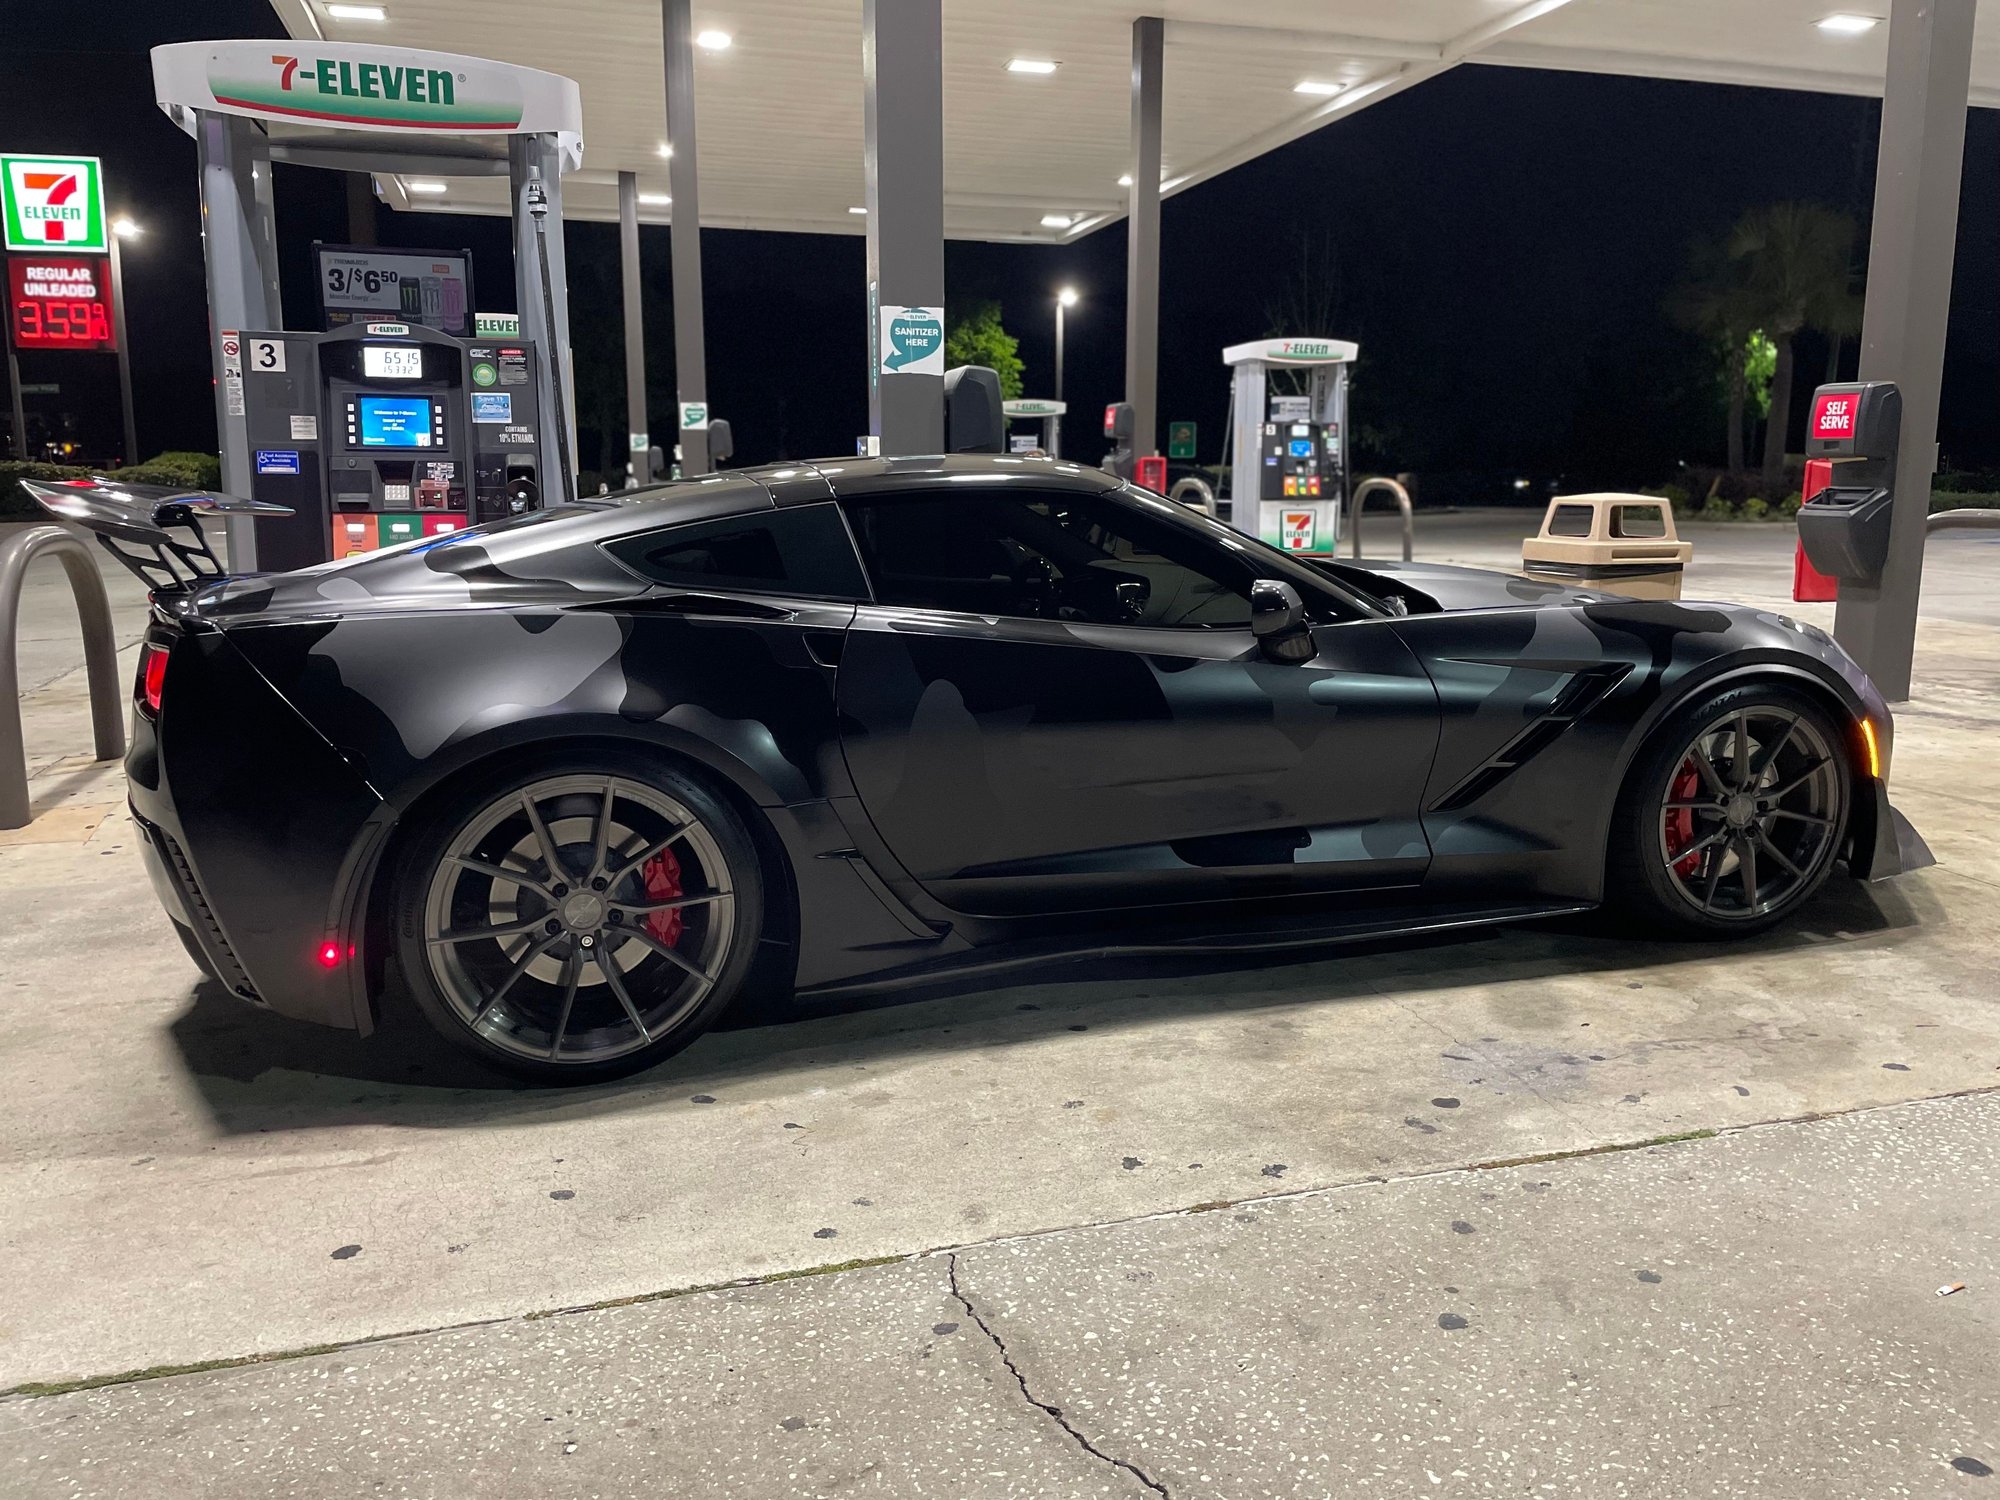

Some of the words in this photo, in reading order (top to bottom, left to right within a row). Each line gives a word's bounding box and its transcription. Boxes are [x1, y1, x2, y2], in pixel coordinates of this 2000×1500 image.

[26, 267, 91, 281] REGULAR
[24, 283, 96, 298] UNLEADED
[894, 327, 939, 337] SANITIZER
[905, 338, 929, 347] HERE
[258, 343, 276, 368] 3
[1826, 401, 1848, 415] SELF
[1820, 415, 1849, 430] SERVE
